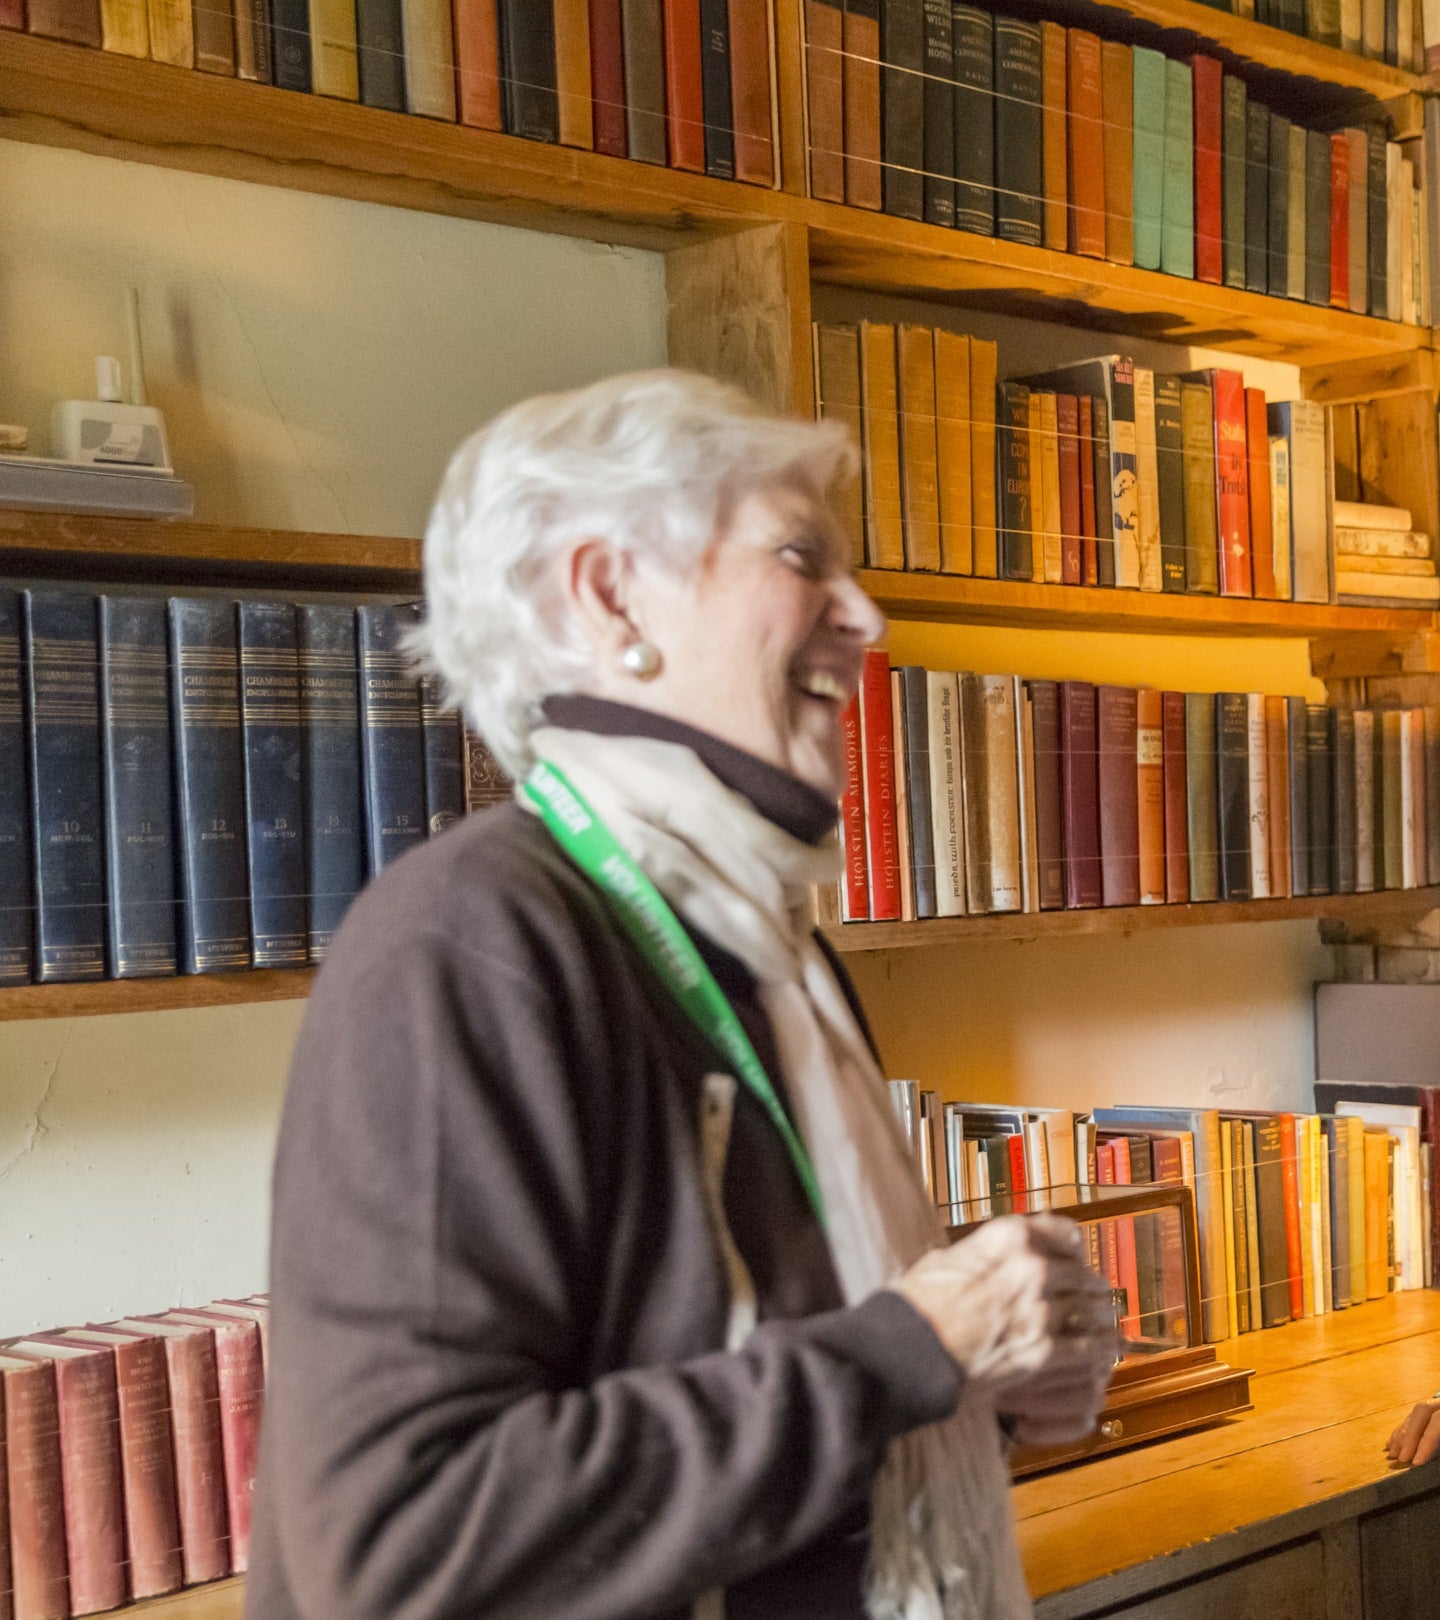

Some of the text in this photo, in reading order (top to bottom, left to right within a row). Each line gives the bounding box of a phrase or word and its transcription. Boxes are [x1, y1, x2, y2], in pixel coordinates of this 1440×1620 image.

[212, 819, 226, 832] 12
[397, 815, 409, 827] 15
[848, 720, 864, 887] HOLSTEIN MEMOIRS
[879, 735, 894, 889] HOLSTEIN DIARIES
